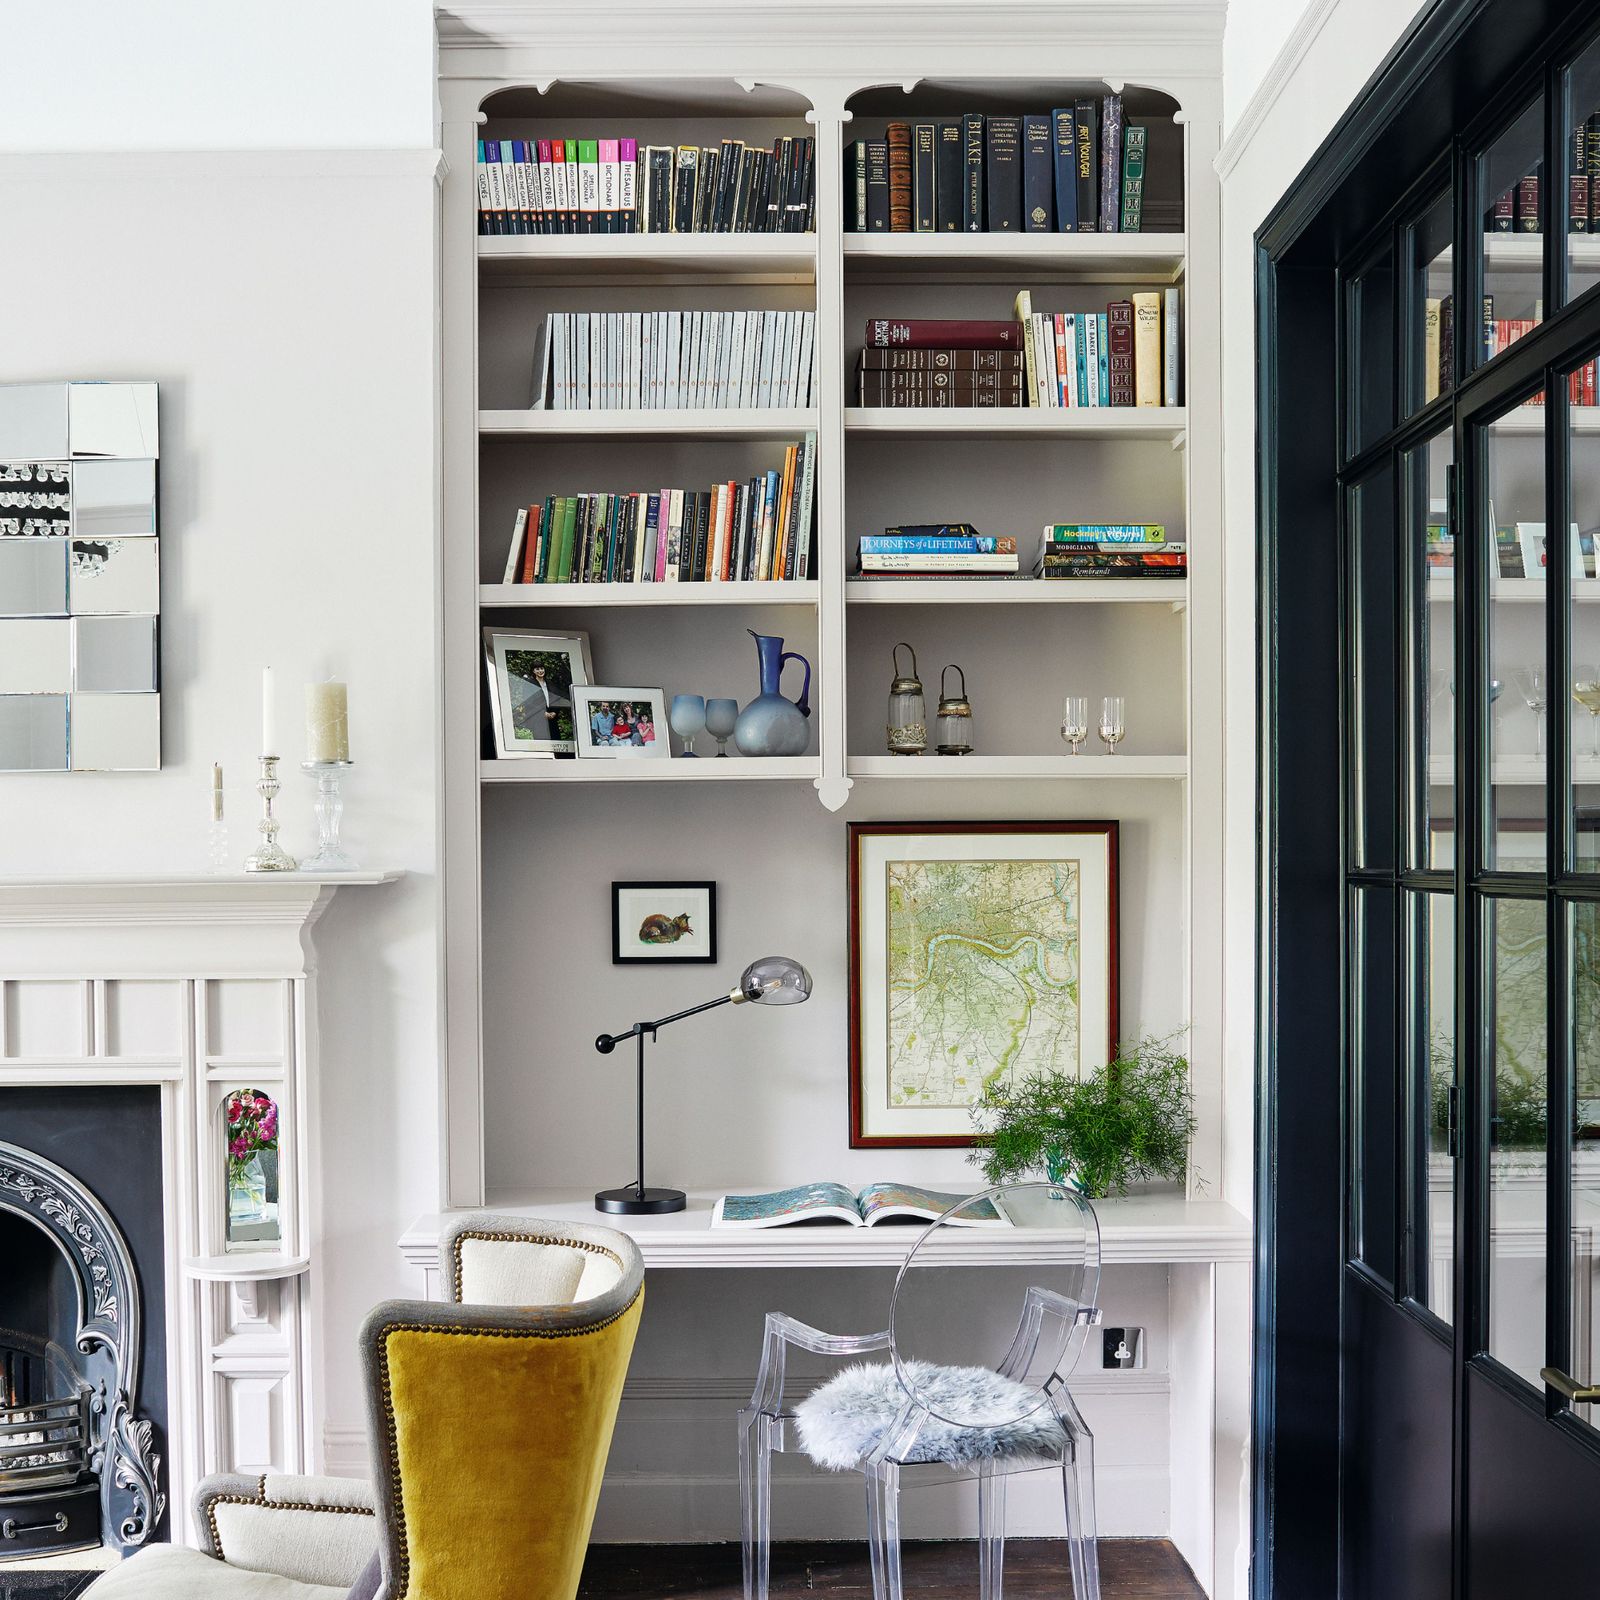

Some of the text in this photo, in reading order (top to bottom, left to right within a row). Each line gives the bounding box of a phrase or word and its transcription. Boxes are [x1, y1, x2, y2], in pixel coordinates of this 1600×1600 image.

[968, 121, 981, 165] BLAKE
[1078, 125, 1090, 141] ART
[480, 174, 488, 199] CLICHÉS
[491, 166, 501, 207] ABBREVIATIONS
[525, 165, 535, 208] PUNCTUATION
[544, 167, 552, 204] PROVERBS
[624, 164, 632, 207] THESAURUS
[864, 539, 915, 550] JOURNEYS
[916, 538, 923, 549] of
[928, 539, 973, 548] LIFETIME
[1064, 530, 1106, 540] Hockney's
